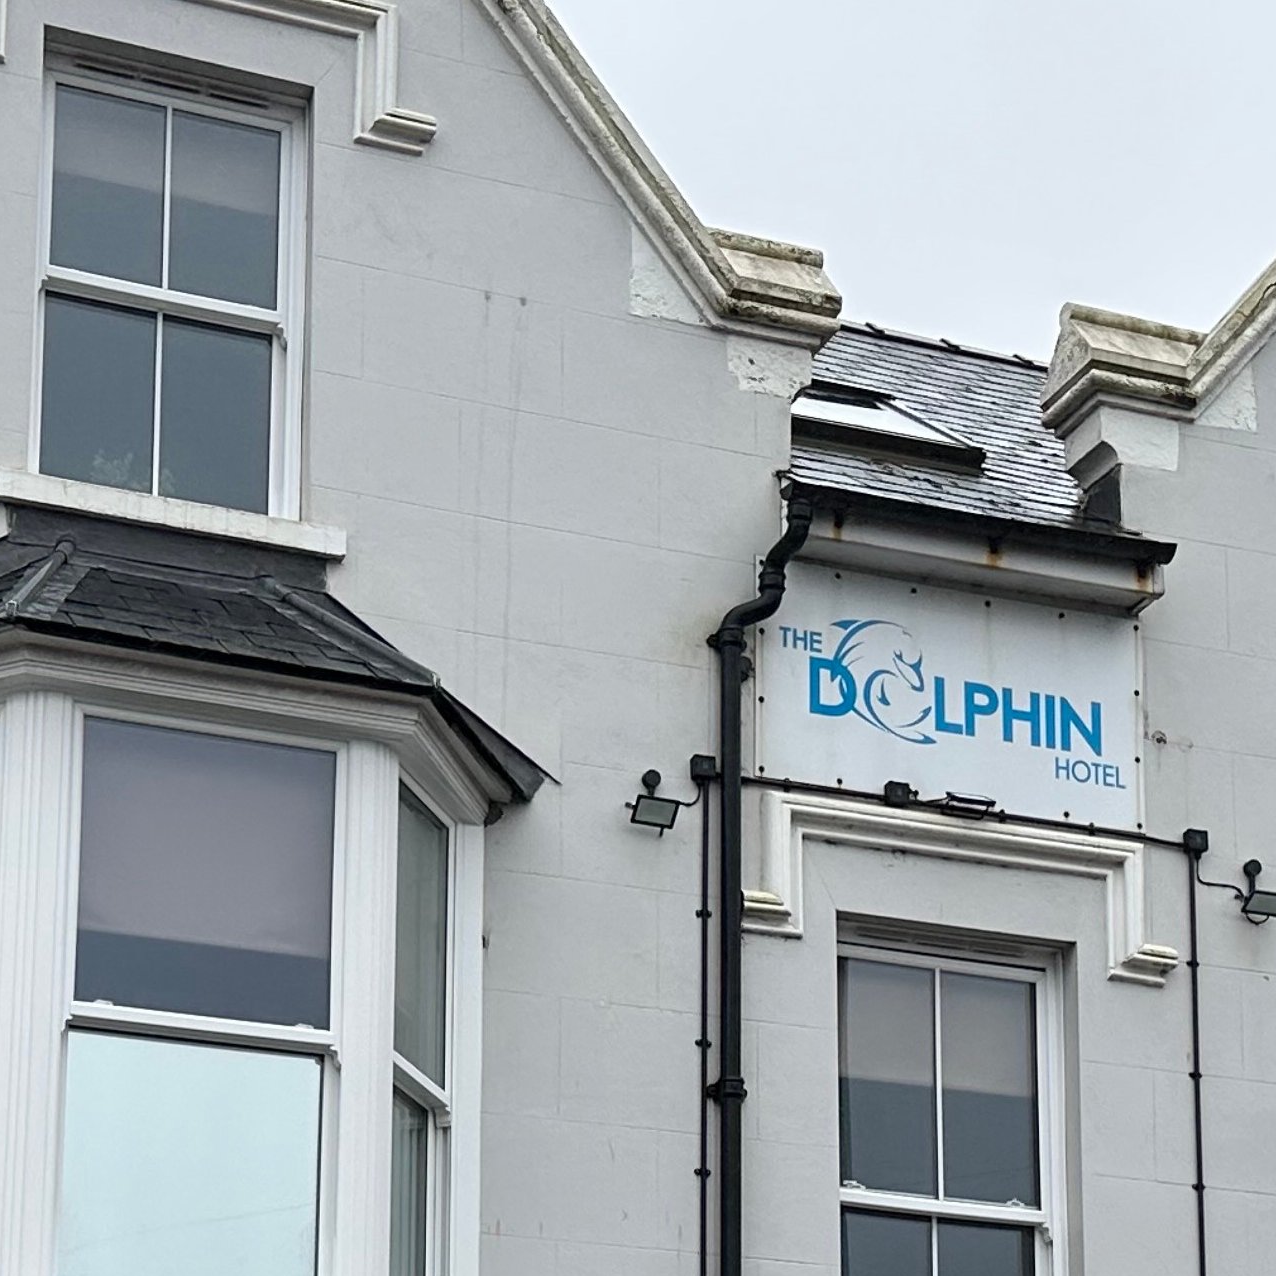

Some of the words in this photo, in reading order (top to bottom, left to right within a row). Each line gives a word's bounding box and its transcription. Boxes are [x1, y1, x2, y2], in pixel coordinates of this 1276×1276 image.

[779, 626, 822, 653] THE
[809, 655, 1102, 757] DOLPHIN
[1055, 757, 1126, 789] HOTEL
